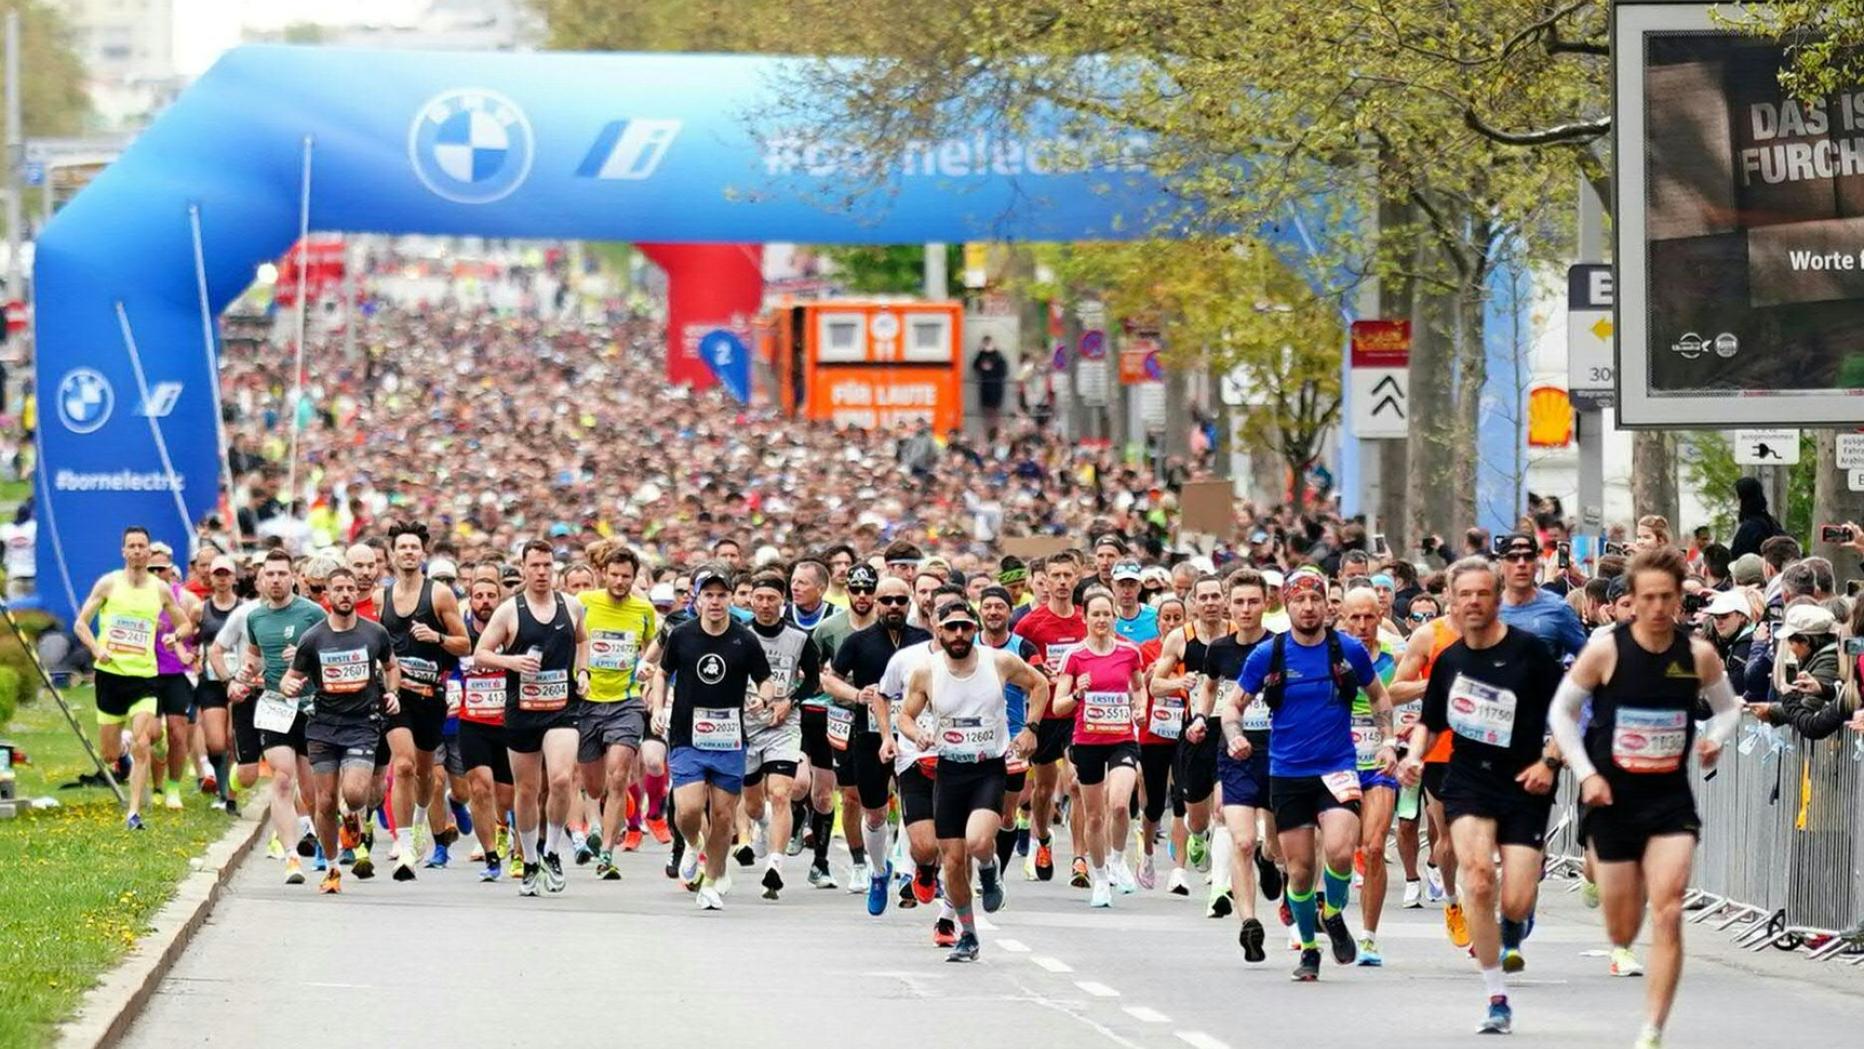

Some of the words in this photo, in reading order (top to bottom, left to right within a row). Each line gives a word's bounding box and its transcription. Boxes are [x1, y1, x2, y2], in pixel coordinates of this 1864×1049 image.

[1751, 98, 1829, 140] DAS
[1742, 138, 1864, 186] FURCH
[1789, 251, 1854, 270] Worte
[1589, 367, 1614, 387] 30
[128, 630, 148, 643] 2431
[327, 654, 351, 663] ERSTE
[343, 665, 366, 678] 2607
[542, 684, 566, 696] 2604
[1092, 695, 1115, 704] ERSTE
[1478, 703, 1513, 722] 11750
[966, 731, 994, 743] 12602
